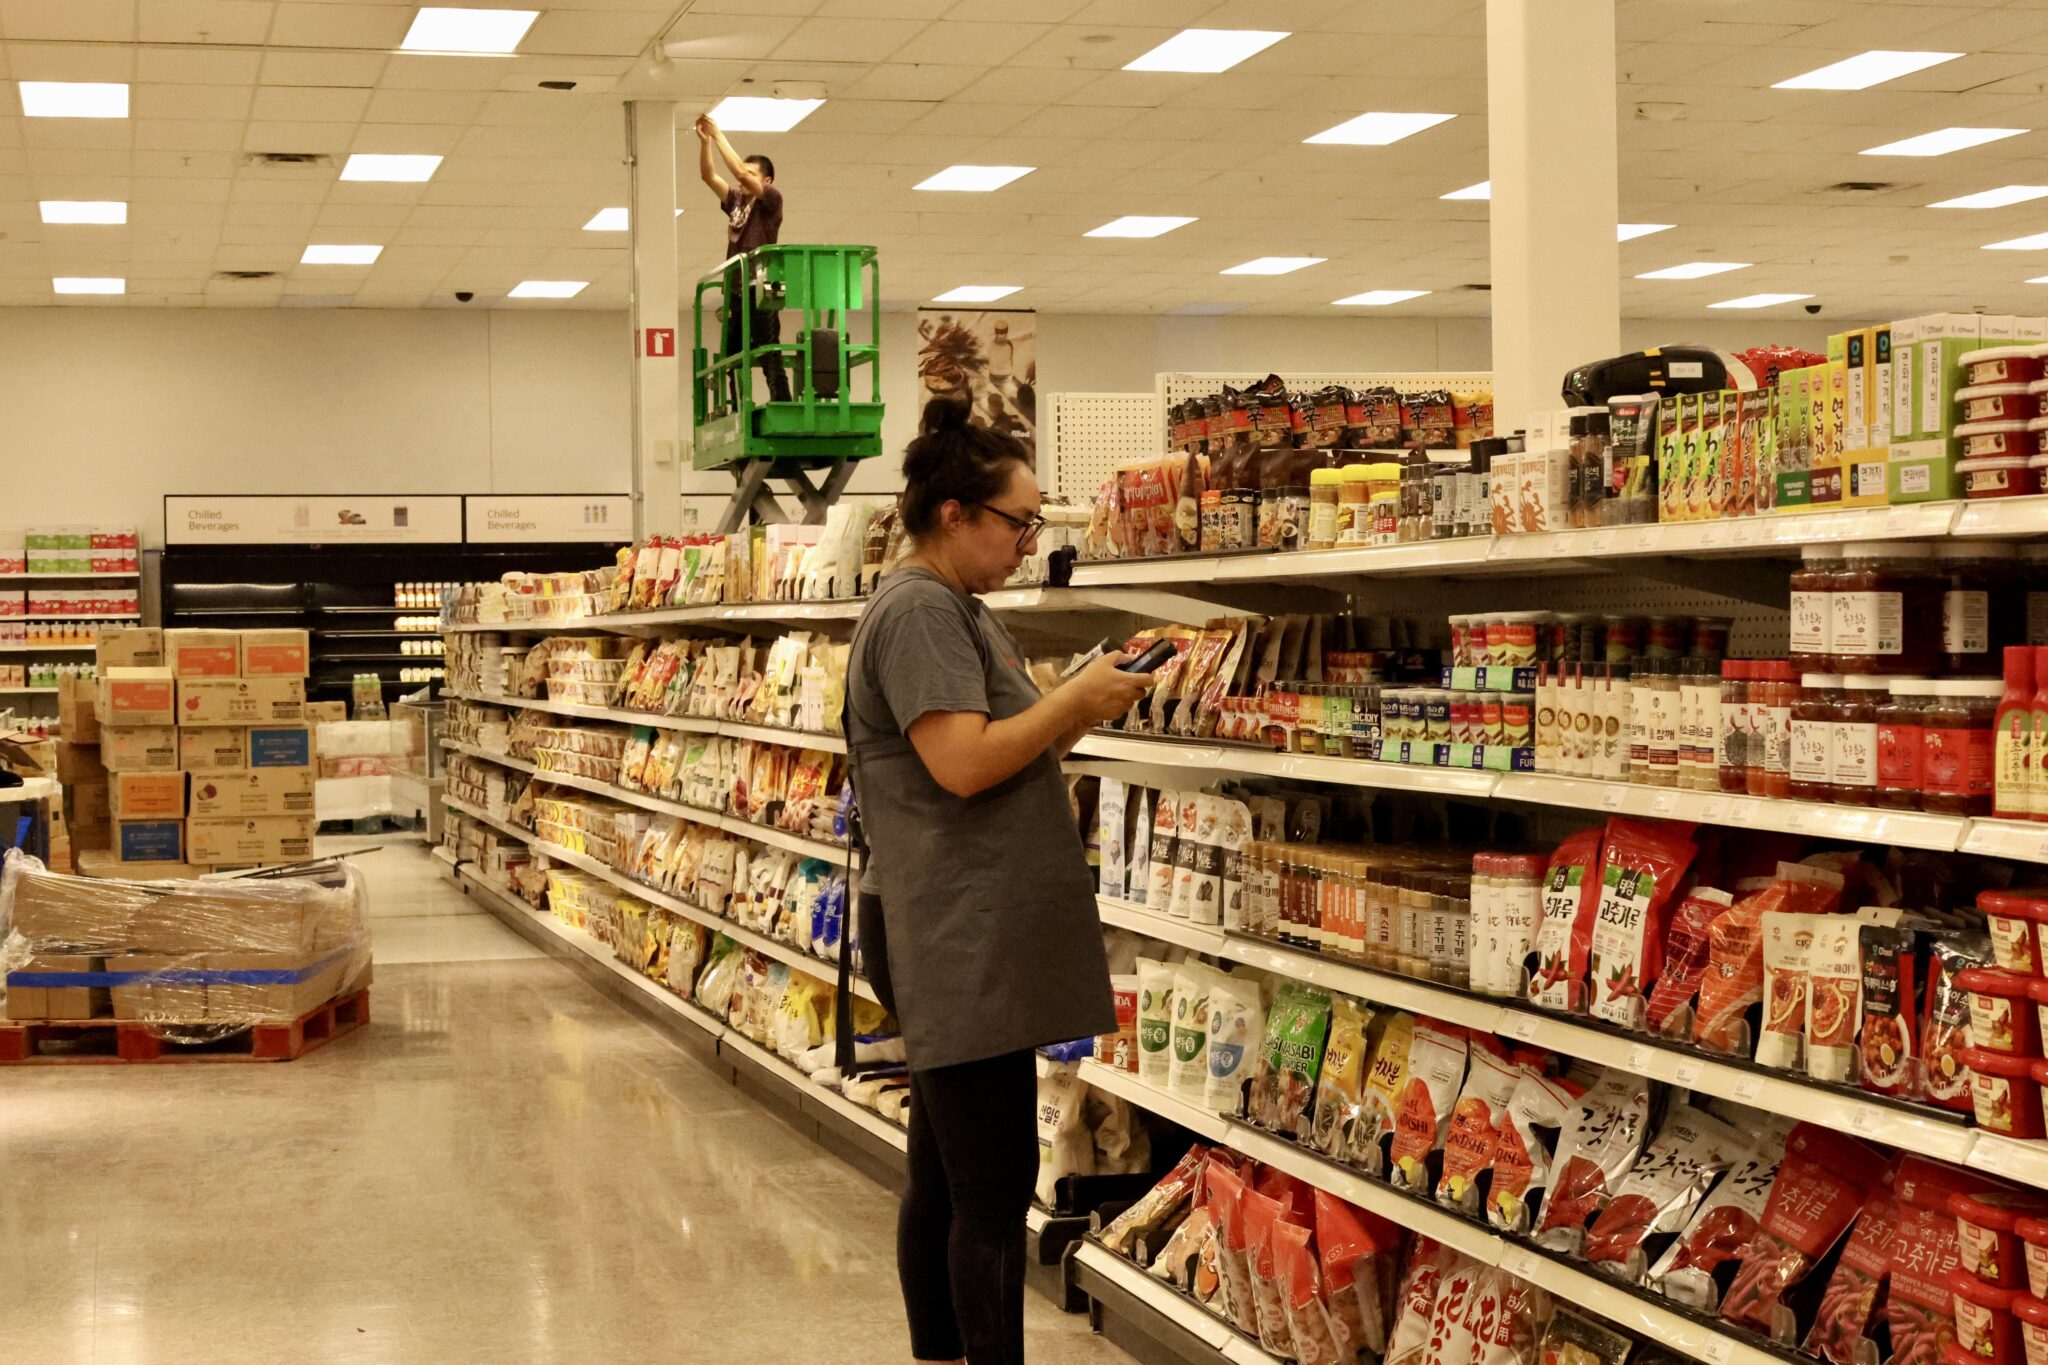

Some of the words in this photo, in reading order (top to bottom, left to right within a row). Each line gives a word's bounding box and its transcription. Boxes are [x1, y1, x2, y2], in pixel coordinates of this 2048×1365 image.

[1011, 430, 1030, 438] filled
[1812, 400, 1825, 456] 연겨자
[1861, 466, 1882, 481] 연겨자
[188, 510, 222, 520] Chilled
[487, 509, 520, 519] Chilled
[188, 521, 240, 532] Beverages
[487, 520, 537, 531] Beverages
[1631, 725, 1646, 737] 참깨
[1656, 729, 1675, 741] 참깨
[2010, 742, 2022, 783] 초고추장
[1600, 899, 1641, 930] 고춧가루
[1434, 916, 1445, 954] 후추가루
[1455, 919, 1466, 957] 후추가루
[1281, 1041, 1315, 1061] WASABI
[1281, 1060, 1308, 1073] POWDER
[1375, 1057, 1400, 1086] 겨자분
[1922, 1280, 1950, 1298] POWDER
